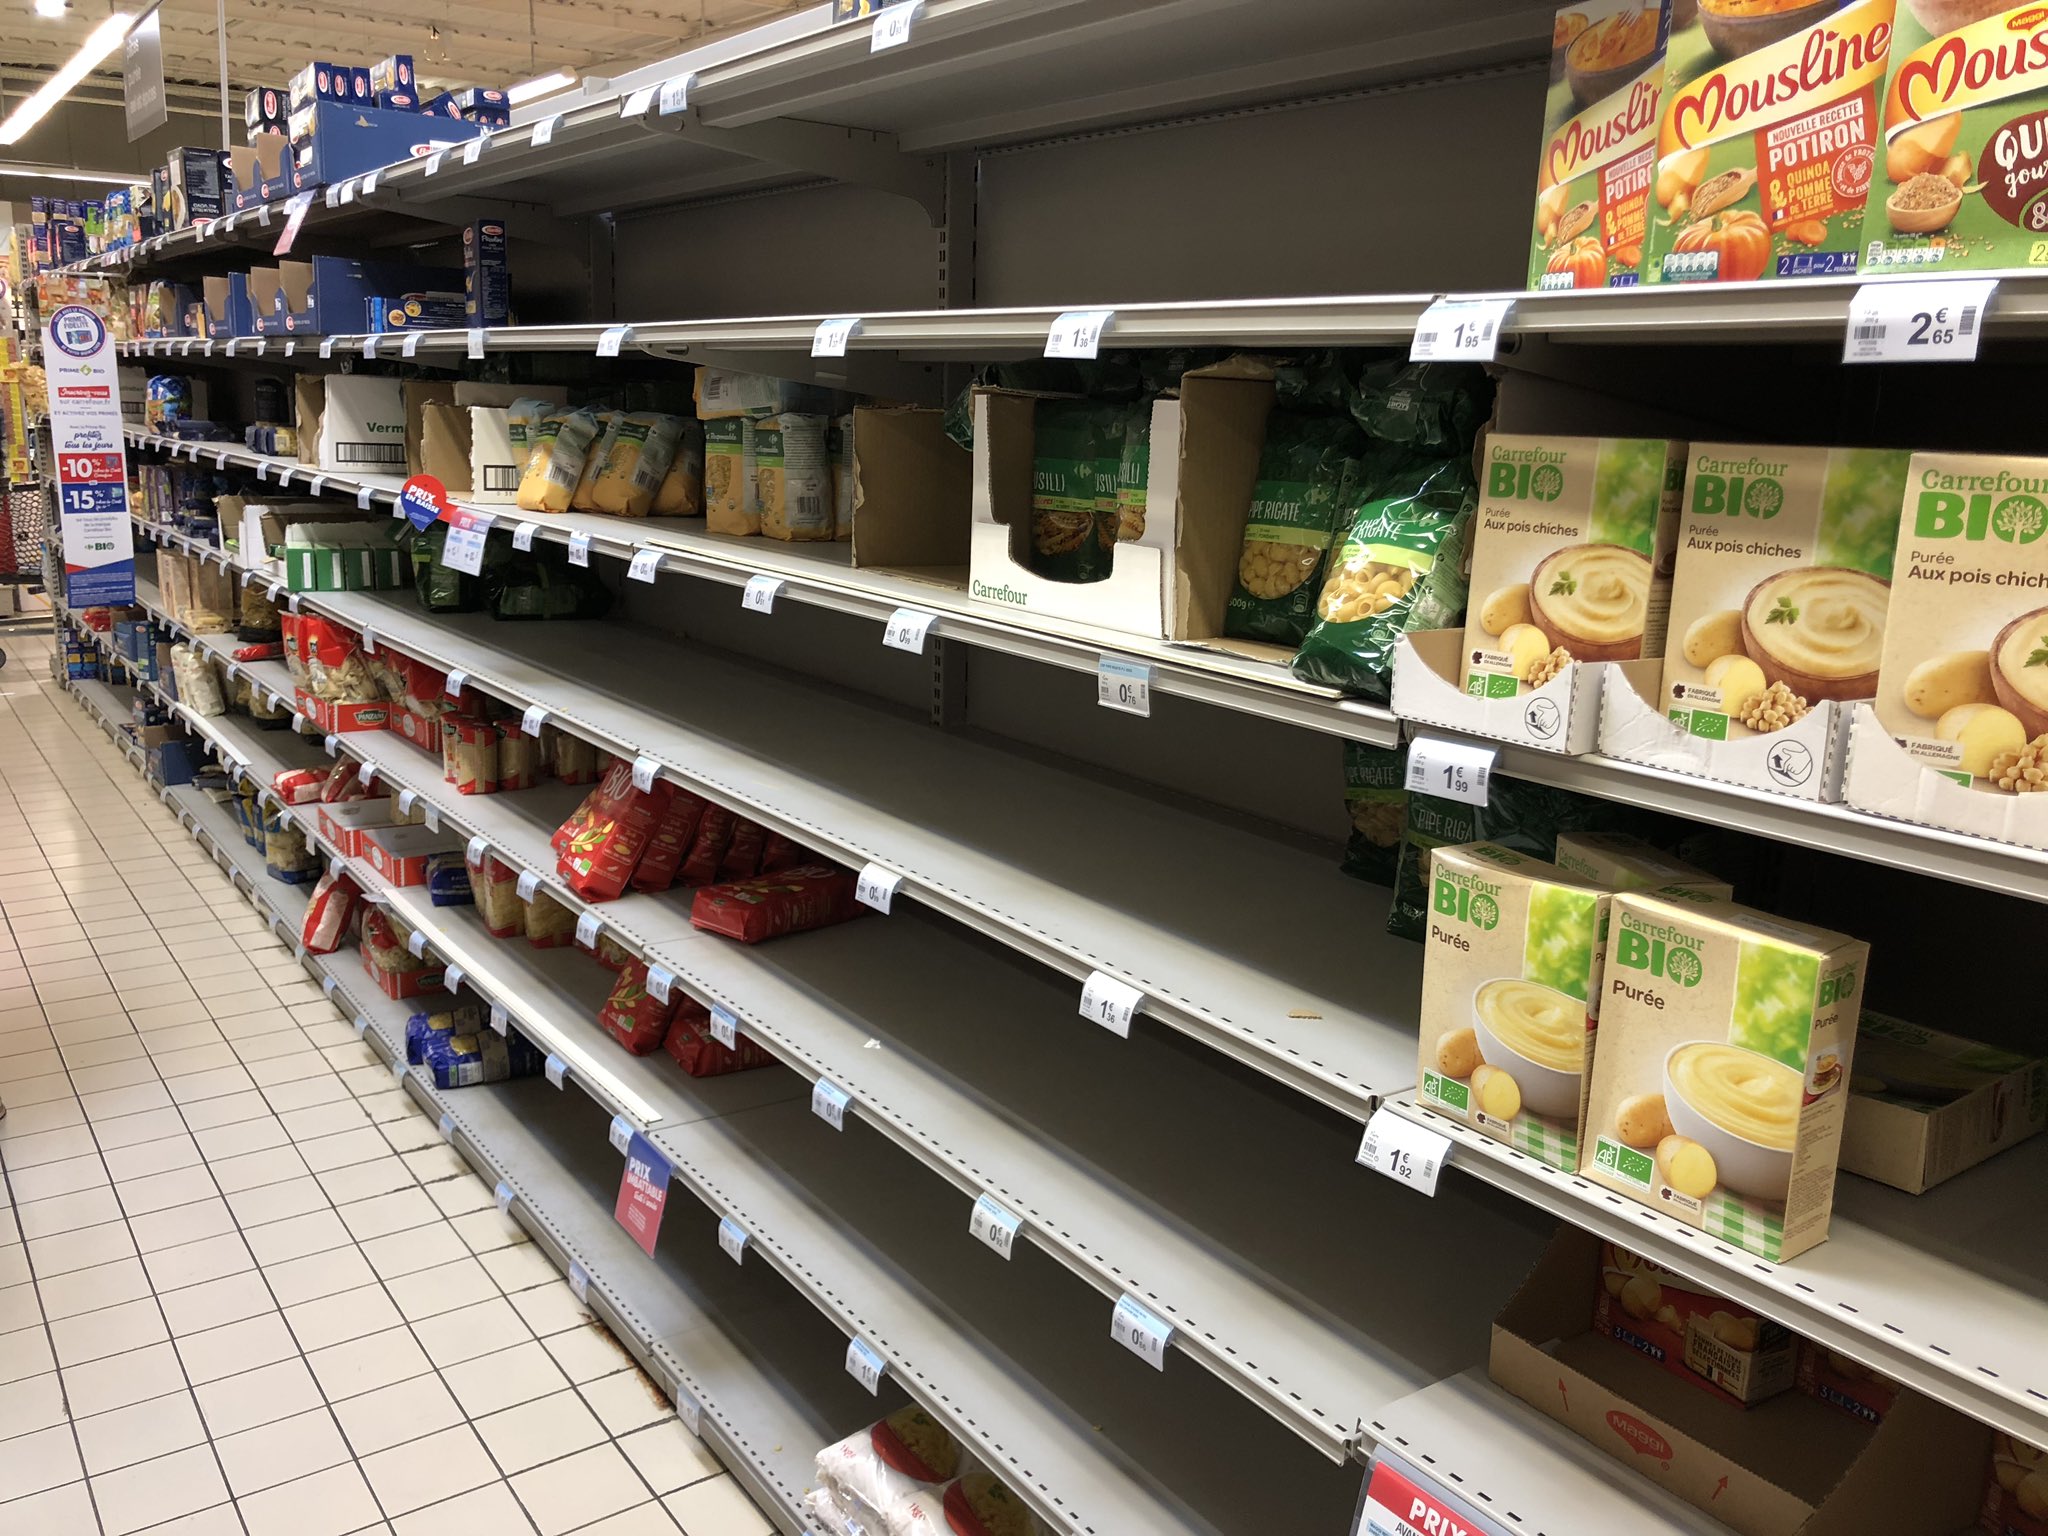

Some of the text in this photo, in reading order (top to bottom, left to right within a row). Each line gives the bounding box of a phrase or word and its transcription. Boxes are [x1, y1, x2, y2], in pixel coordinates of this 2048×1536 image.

[2012, 11, 2045, 28] Maggi
[1674, 20, 1891, 149] Mousline
[1899, 30, 2048, 122] Mous
[1550, 81, 1662, 185] Mousli
[1773, 102, 1859, 143] NOUVELLE RECETTE
[1769, 117, 1865, 173] POTIRON
[1995, 116, 2048, 170] QUI
[1637, 147, 1655, 166] RECE
[1606, 165, 1652, 204] POTIR
[1787, 160, 1830, 189] QUINOA
[1788, 175, 1832, 203] POMME
[1790, 191, 1833, 215] DE TERRE
[1617, 208, 1645, 231] POMME
[1780, 258, 1789, 275] 2
[1825, 255, 1835, 273] 2
[1073, 328, 1081, 347] 1
[1080, 338, 1088, 347] 36
[1454, 323, 1465, 348] 1
[1465, 336, 1479, 348] 95
[1907, 307, 1954, 345] 2 € 65
[1492, 445, 1567, 464] Carrefour
[62, 458, 92, 478] -10
[1117, 462, 1140, 484] USILLI
[1697, 456, 1789, 477] Carrefour
[1034, 472, 1065, 491] USILLI
[1488, 462, 1564, 502] BIO
[65, 490, 95, 510] -15
[405, 494, 440, 514] EN BAISSE
[408, 484, 436, 504] PRIX
[1692, 474, 1784, 520] BIO
[1264, 501, 1301, 522] RIGATE
[1485, 507, 1510, 518] Purée
[1914, 492, 2048, 544] BIO
[1484, 518, 1578, 537] Aux pois chiches
[1689, 525, 1719, 536] Purée
[1687, 537, 1801, 558] Aux pois chiches
[1911, 551, 1954, 564] Purée
[1908, 565, 2048, 588] Aux pois chich
[973, 579, 1028, 605] Carrefour
[899, 628, 906, 643] 0
[1484, 653, 1509, 663] FABRIQUÉ
[1119, 683, 1127, 703] 0
[1128, 695, 1136, 705] 76
[1468, 682, 1484, 696] AB
[1688, 688, 1717, 698] FABRIQUÉ
[358, 713, 385, 721] PANZANI
[1911, 742, 1954, 753] FABRIQUÉ
[1920, 751, 1960, 760] ALLEMAGNE
[604, 764, 633, 800] BIO
[1443, 765, 1468, 792] 1 € 99
[1417, 809, 1472, 843] PIPE RIGA
[1436, 863, 1502, 897] Carrefour
[869, 886, 875, 900] 0
[1433, 879, 1499, 931] BIO
[1431, 925, 1470, 951] Purée
[1621, 912, 1705, 951] Carrefour
[1616, 928, 1702, 987] BIO
[1612, 980, 1665, 1010] Purée
[1818, 972, 1856, 1008] BIO
[1100, 1000, 1108, 1018] 1
[1106, 1013, 1115, 1024] 36
[1814, 1014, 1839, 1030] Purée
[1390, 1149, 1412, 1179] 1 € 92
[1597, 1147, 1614, 1165] AB
[629, 1156, 651, 1182] PRIX
[989, 1223, 997, 1241] 0
[1132, 1328, 1139, 1345] 0
[1613, 1327, 1649, 1354] 3 2
[1819, 1386, 1862, 1414] 3 2
[1612, 1415, 1664, 1453] Maggi
[1409, 1497, 1468, 1536] PRIX
